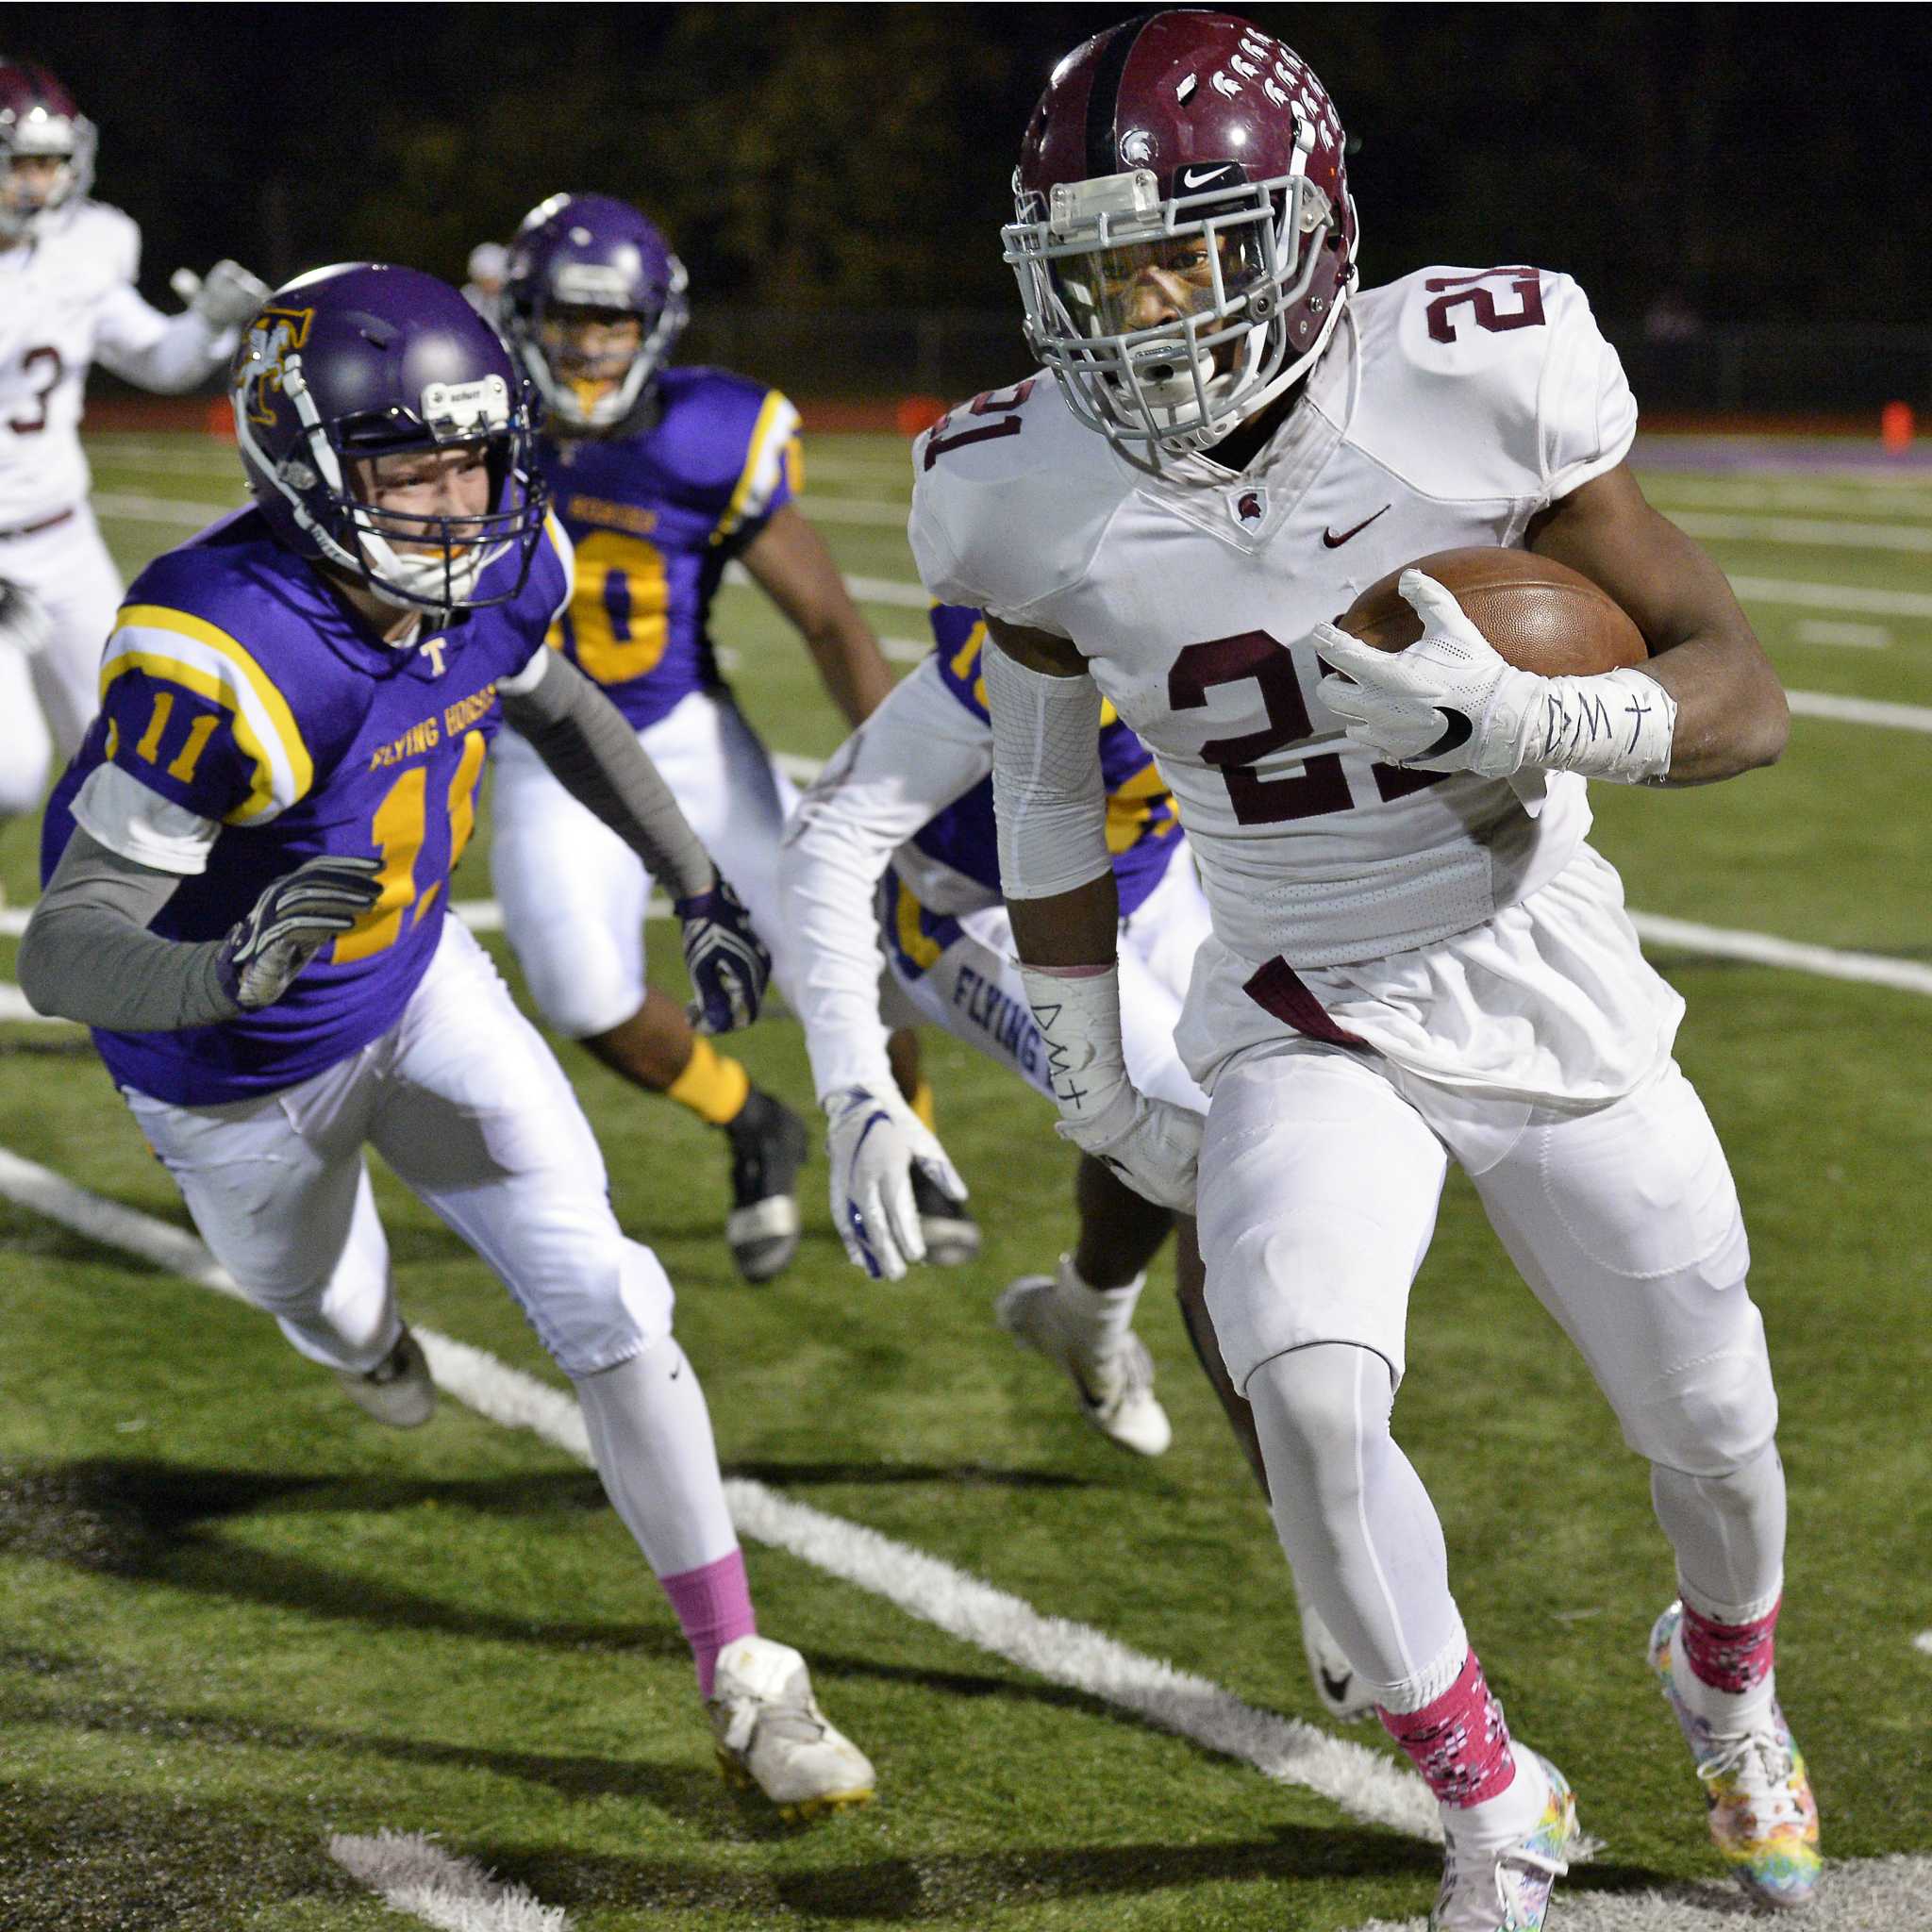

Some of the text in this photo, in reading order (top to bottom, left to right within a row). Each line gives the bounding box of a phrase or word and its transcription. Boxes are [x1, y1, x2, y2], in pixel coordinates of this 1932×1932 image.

[1425, 268, 1546, 344] 21
[419, 637, 447, 677] T
[135, 691, 221, 785] 11
[368, 716, 441, 773] FLYING
[952, 964, 1041, 1074] FLYING
